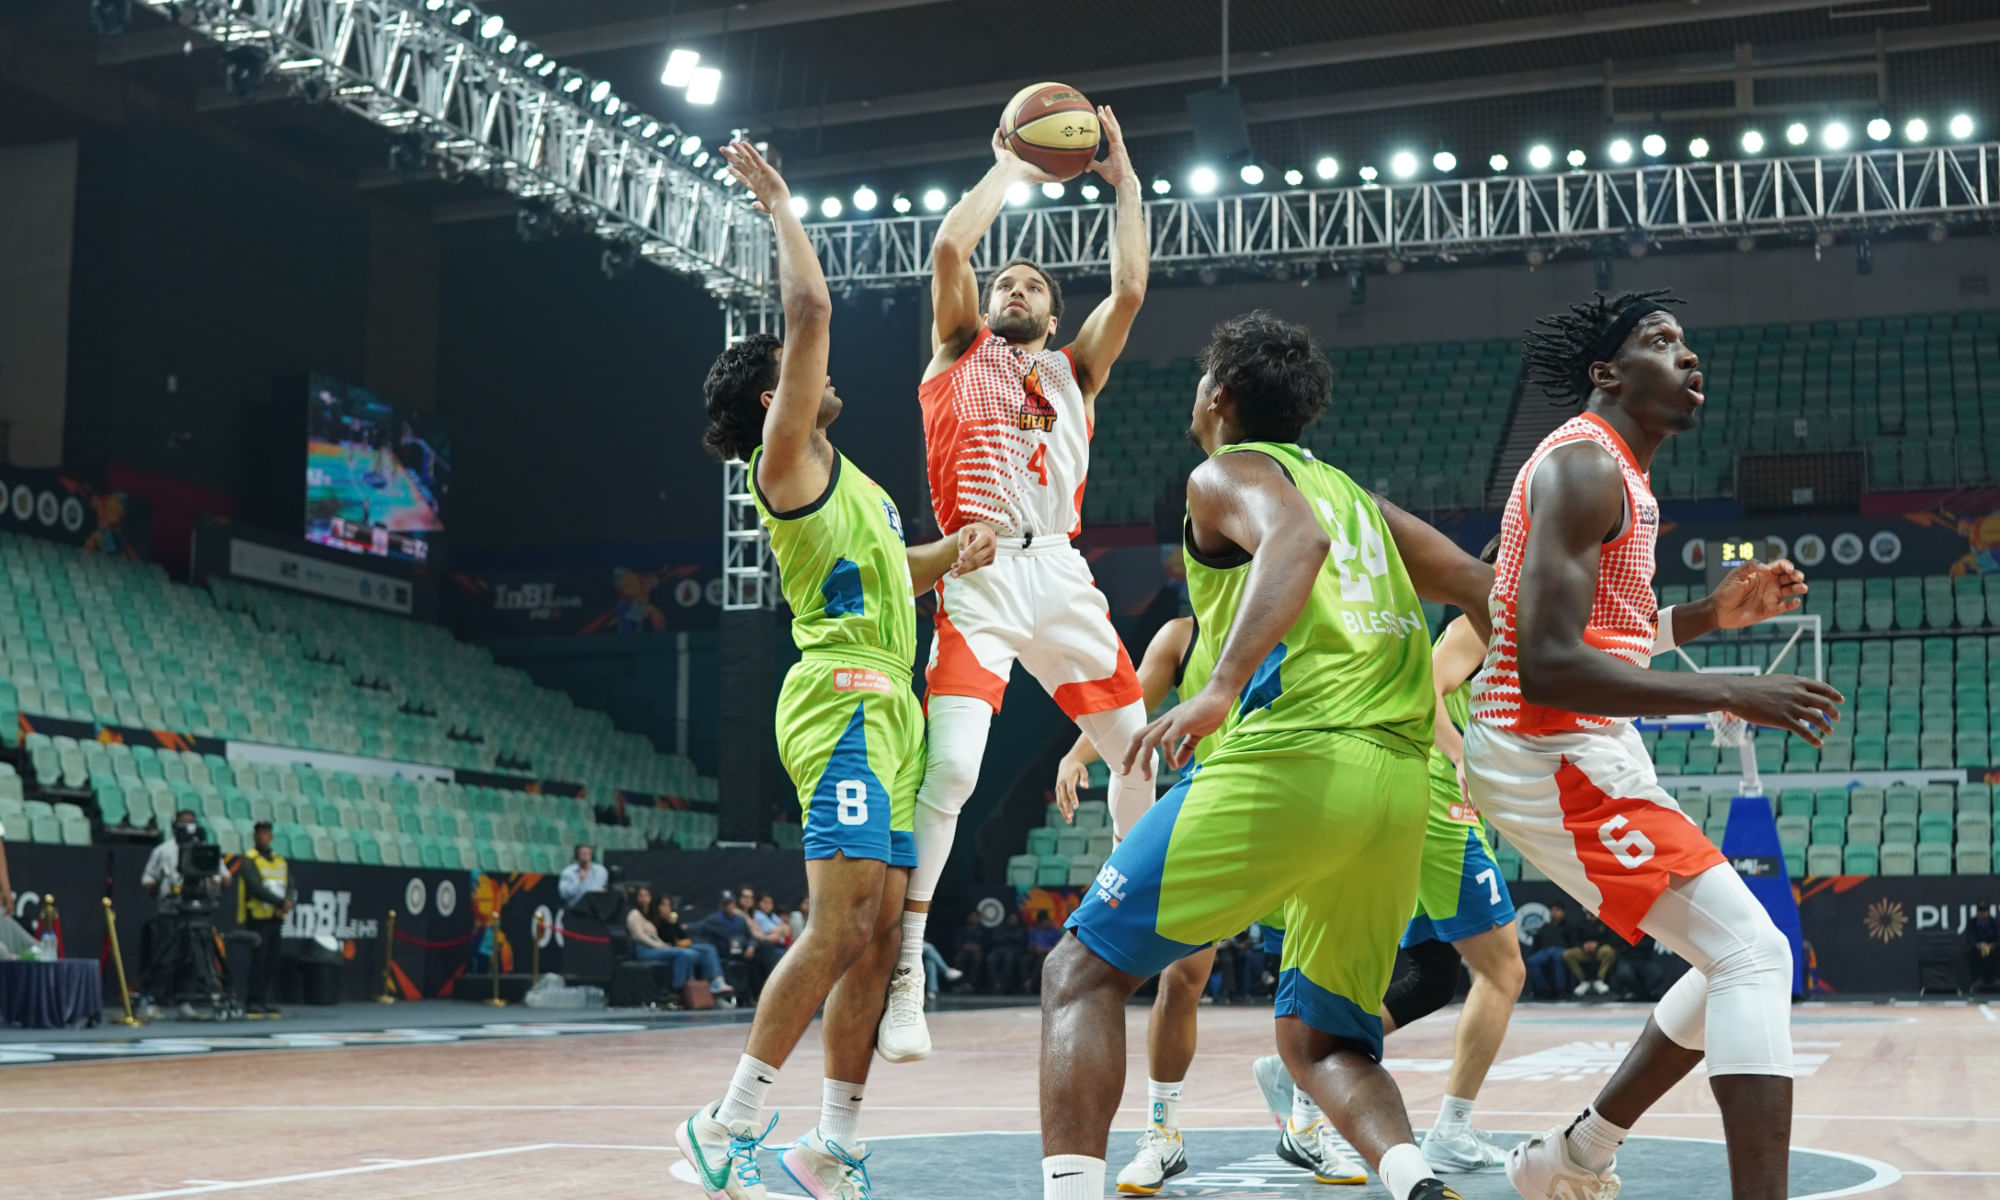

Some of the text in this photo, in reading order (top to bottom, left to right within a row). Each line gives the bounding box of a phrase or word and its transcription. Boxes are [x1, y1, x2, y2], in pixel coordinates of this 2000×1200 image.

[1020, 414, 1057, 432] HEAT
[1026, 443, 1048, 486] 4
[836, 780, 869, 826] 8
[1597, 813, 1656, 869] 6
[1475, 868, 1502, 906] 7
